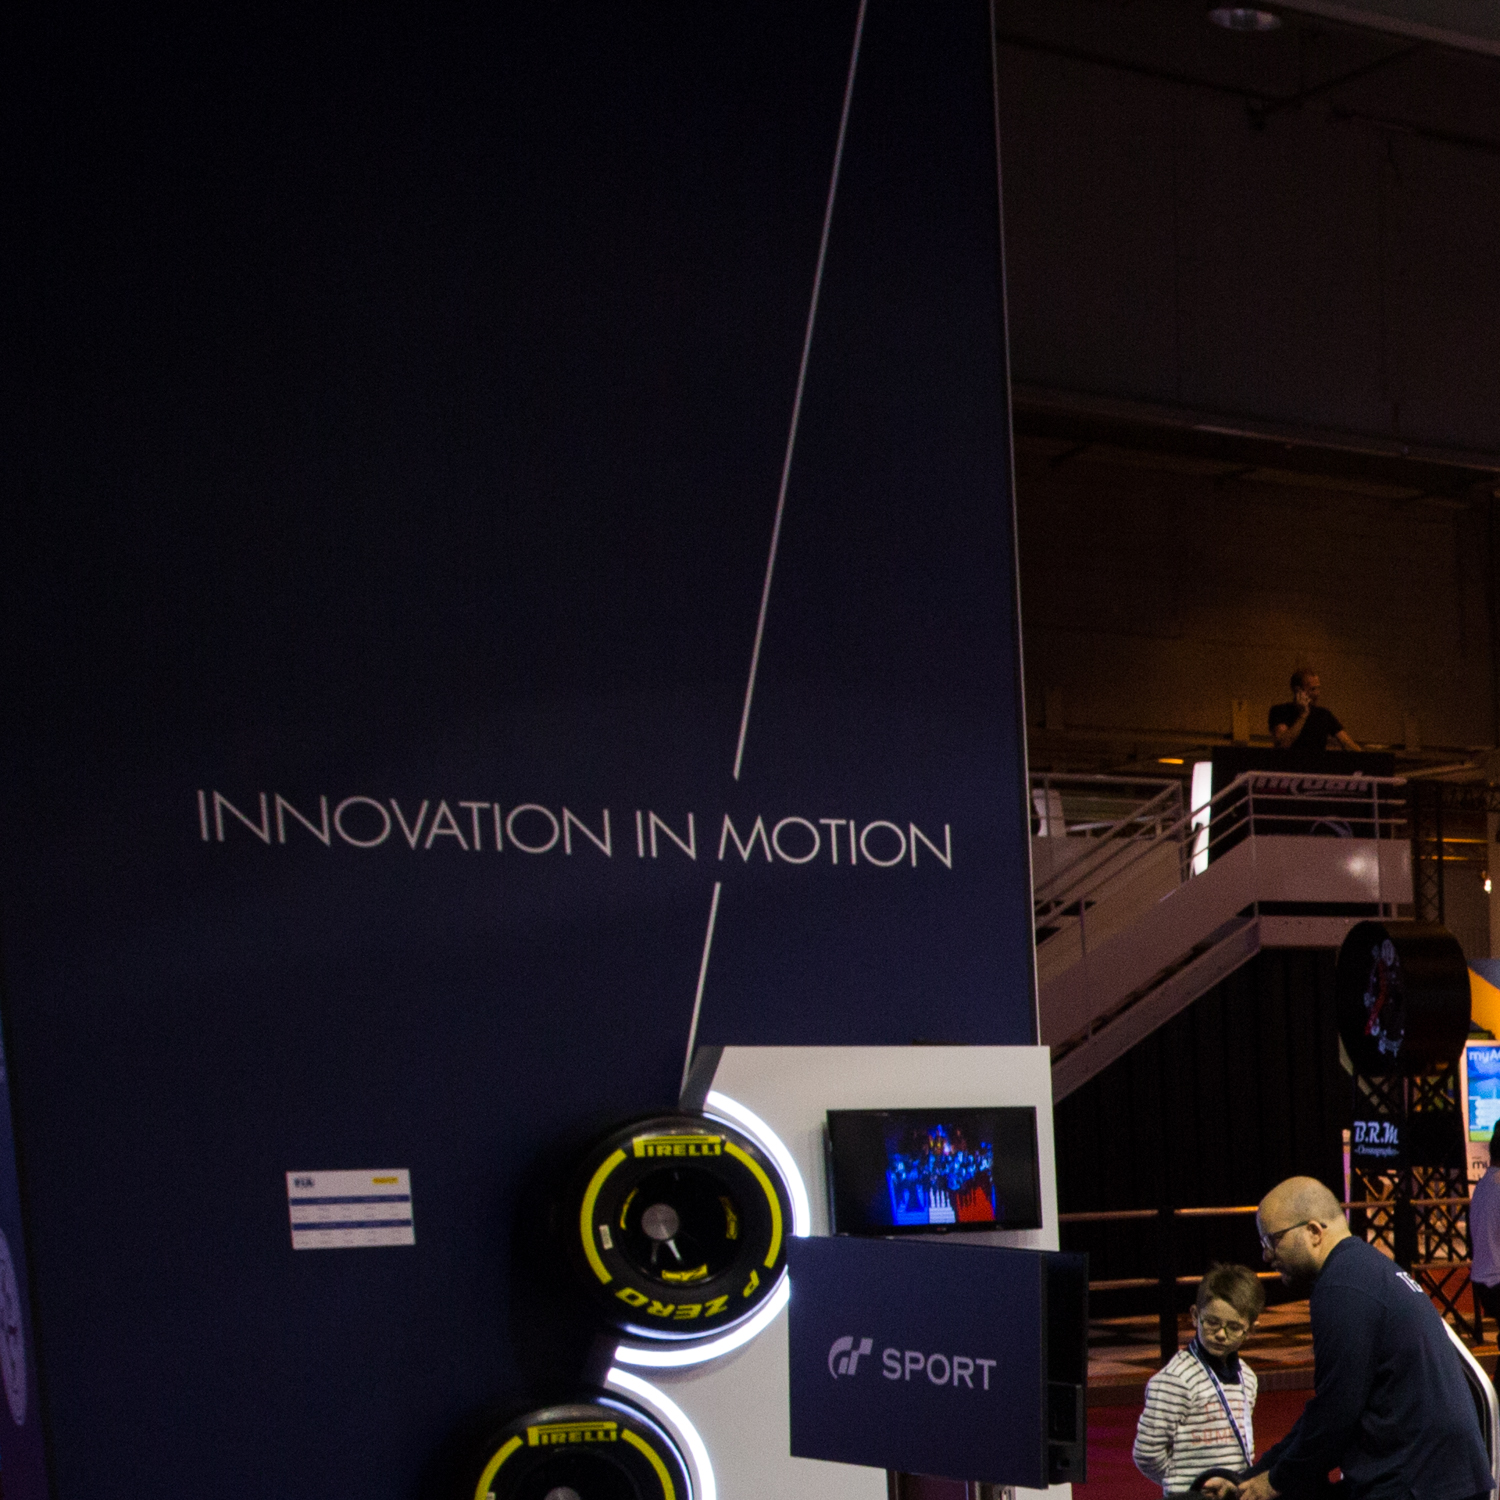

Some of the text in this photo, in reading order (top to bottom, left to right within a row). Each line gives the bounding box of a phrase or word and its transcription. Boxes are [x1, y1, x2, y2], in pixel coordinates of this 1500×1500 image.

[197, 791, 953, 870] INNOVATION IN MOTION
[632, 1135, 722, 1158] PIRELLI
[614, 1269, 760, 1320] P ZERO
[882, 1348, 997, 1391] SPORT
[527, 1421, 618, 1446] PIRELLI
